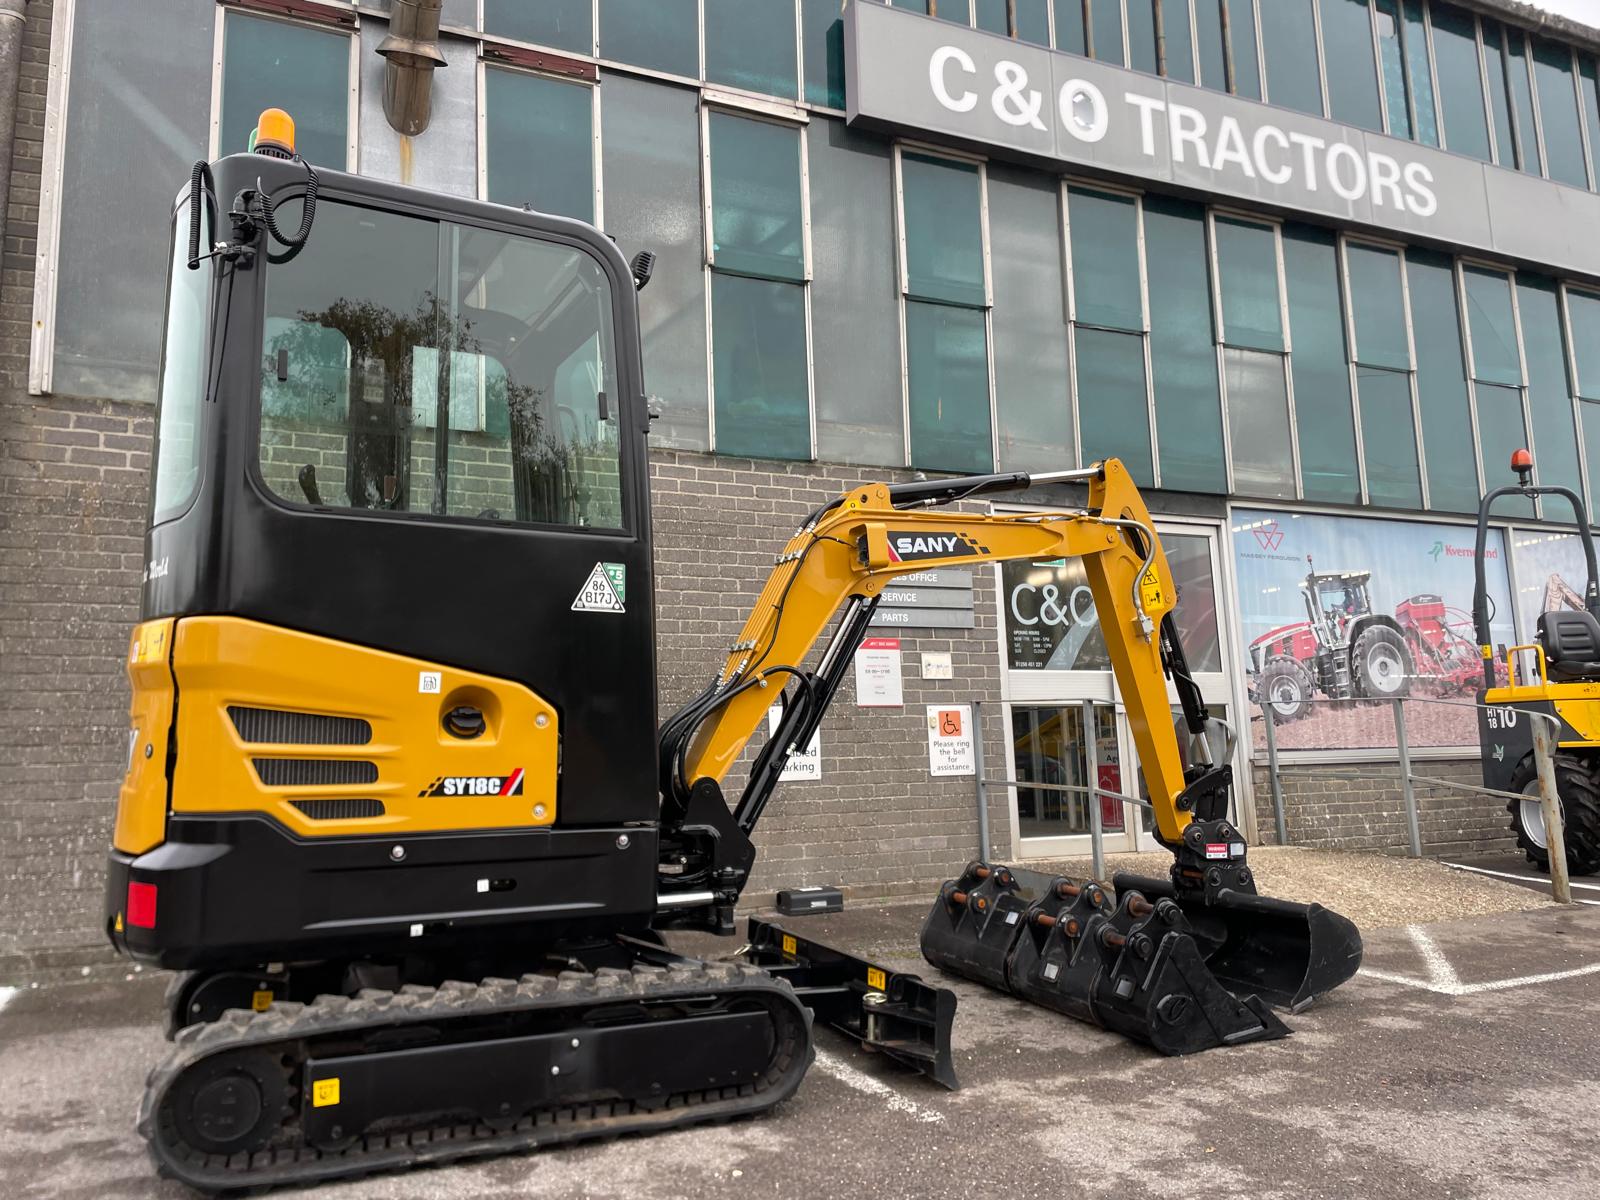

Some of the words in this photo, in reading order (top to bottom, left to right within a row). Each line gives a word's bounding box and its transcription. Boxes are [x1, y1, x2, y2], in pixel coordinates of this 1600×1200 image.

[1125, 92, 1438, 217] TRACTORS
[896, 536, 958, 553] SANY
[908, 573, 938, 582] OFFICE
[592, 580, 605, 591] 86
[881, 592, 917, 602] SERVICE
[881, 613, 909, 622] PARTS
[1487, 717, 1498, 728] 18
[1497, 706, 1517, 728] 10
[933, 740, 954, 748] Please
[783, 762, 815, 774] arking
[936, 763, 970, 771] assistance
[443, 777, 501, 795] SY18C
